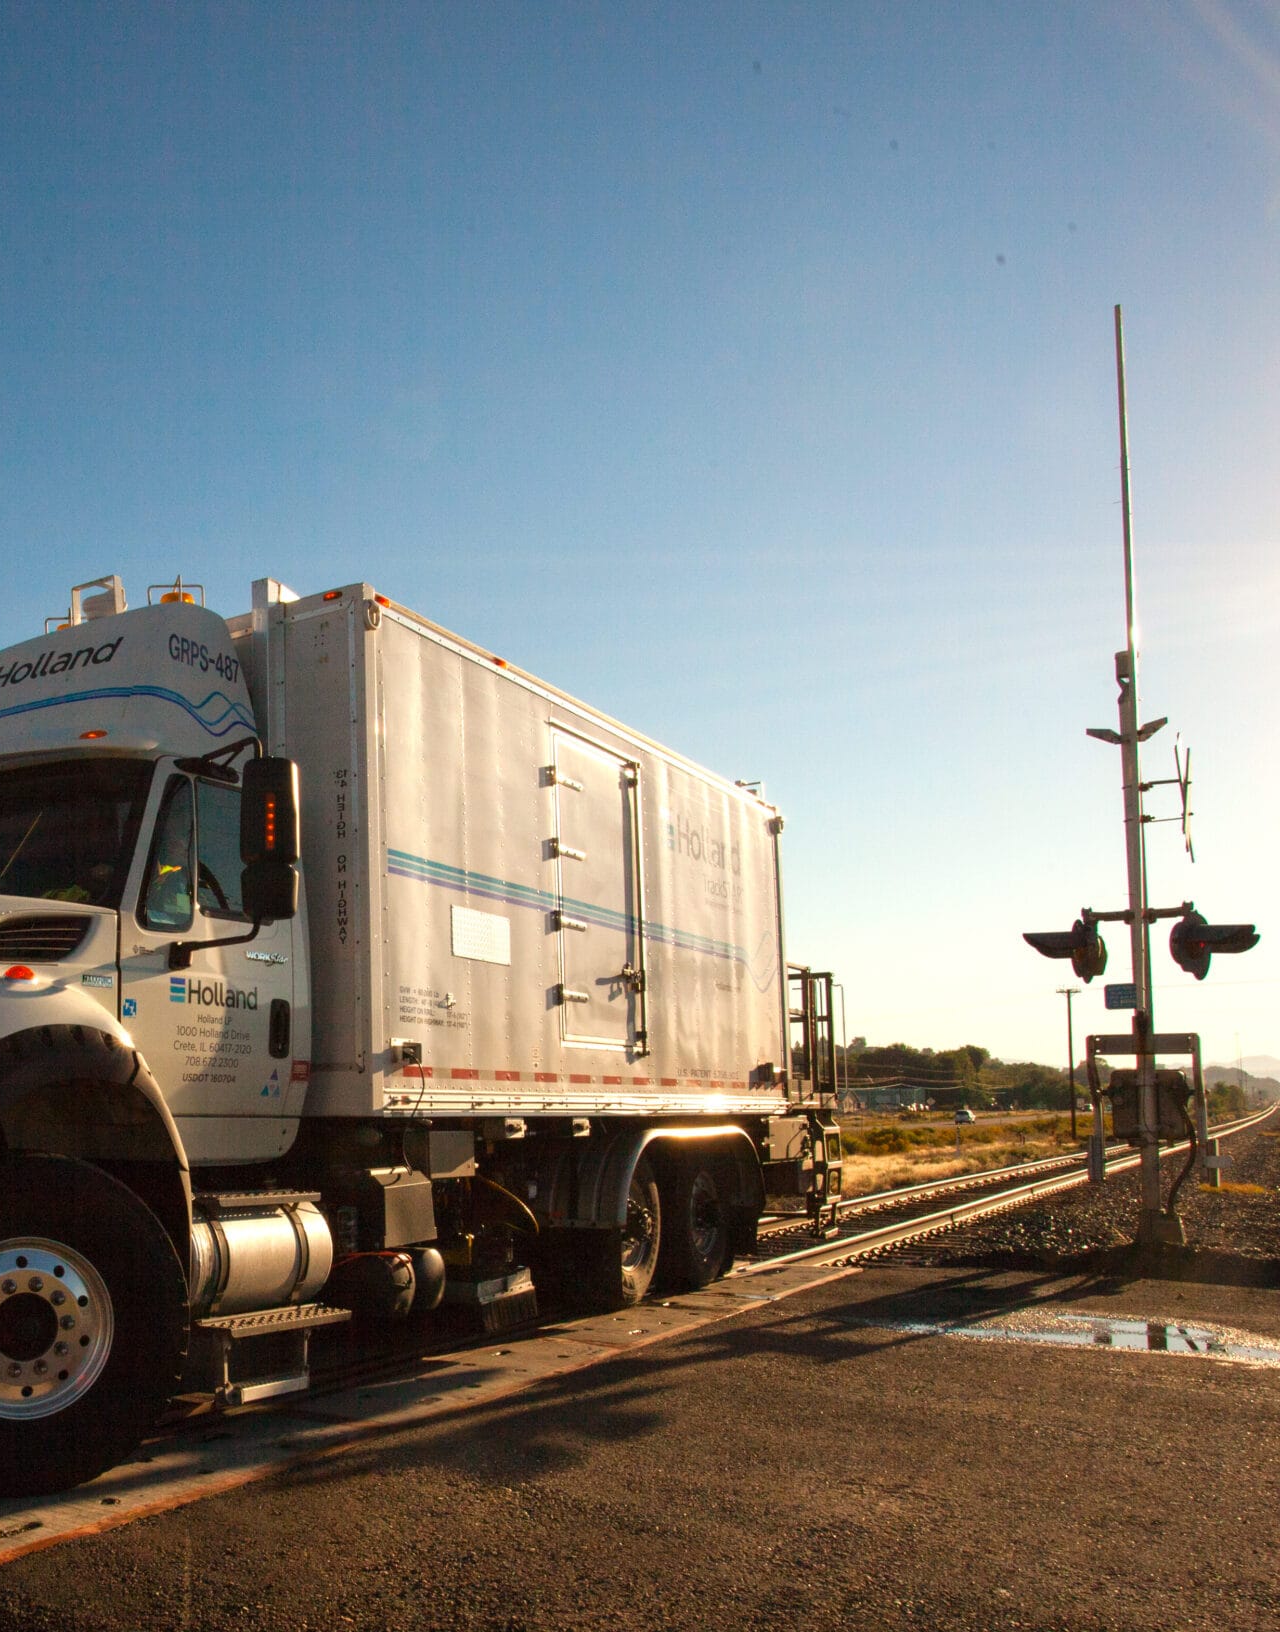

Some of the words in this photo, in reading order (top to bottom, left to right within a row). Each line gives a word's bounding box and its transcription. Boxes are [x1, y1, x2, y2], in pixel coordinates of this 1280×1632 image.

[168, 633, 240, 684] GRPS-487
[187, 978, 258, 1011] Holland
[197, 1014, 223, 1024] Holland
[176, 1025, 198, 1037] 1000
[199, 1027, 229, 1039] Holland
[230, 1029, 250, 1041] Drive
[173, 1040, 198, 1053] Crete,
[199, 1042, 207, 1053] IL
[209, 1043, 252, 1055] 60417-2120
[182, 1073, 209, 1083] USDOT
[690, 1069, 712, 1079] PATENT
